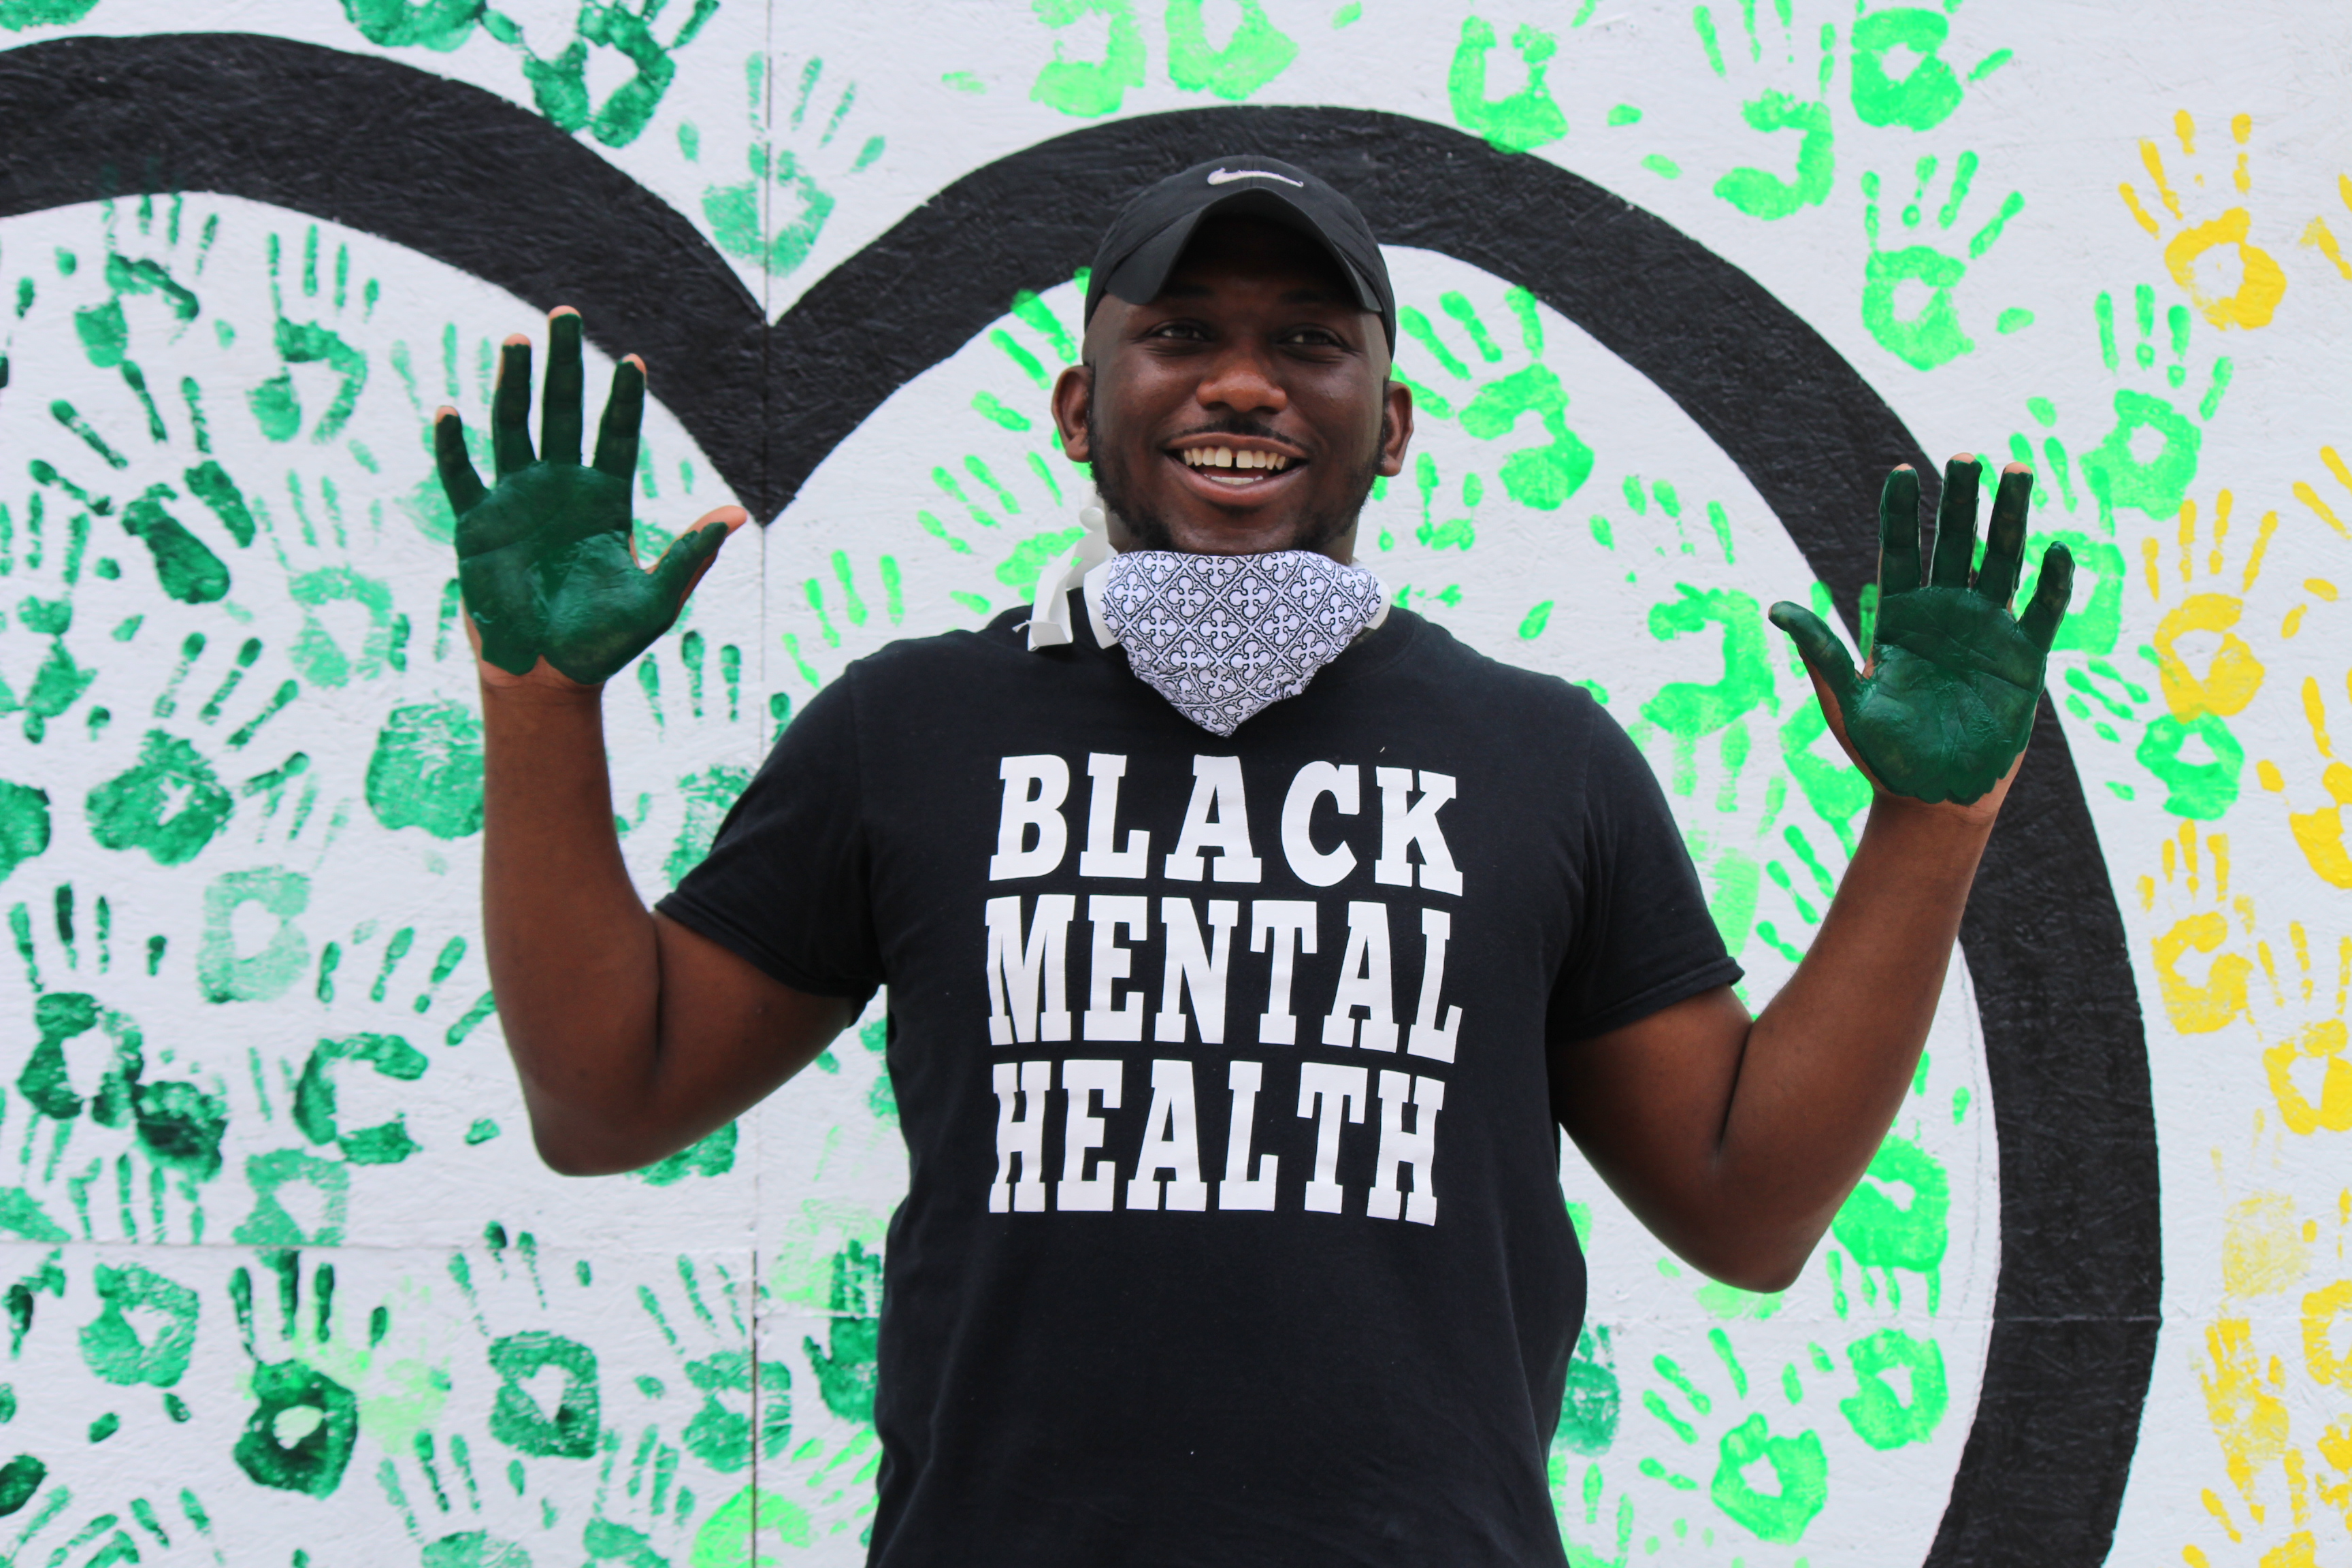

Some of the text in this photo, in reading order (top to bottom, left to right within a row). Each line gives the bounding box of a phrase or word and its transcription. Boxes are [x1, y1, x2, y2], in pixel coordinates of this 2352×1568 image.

[989, 751, 1463, 897] BLACK
[985, 894, 1463, 1064] MENTAL
[988, 1058, 1446, 1226] HEALTH
